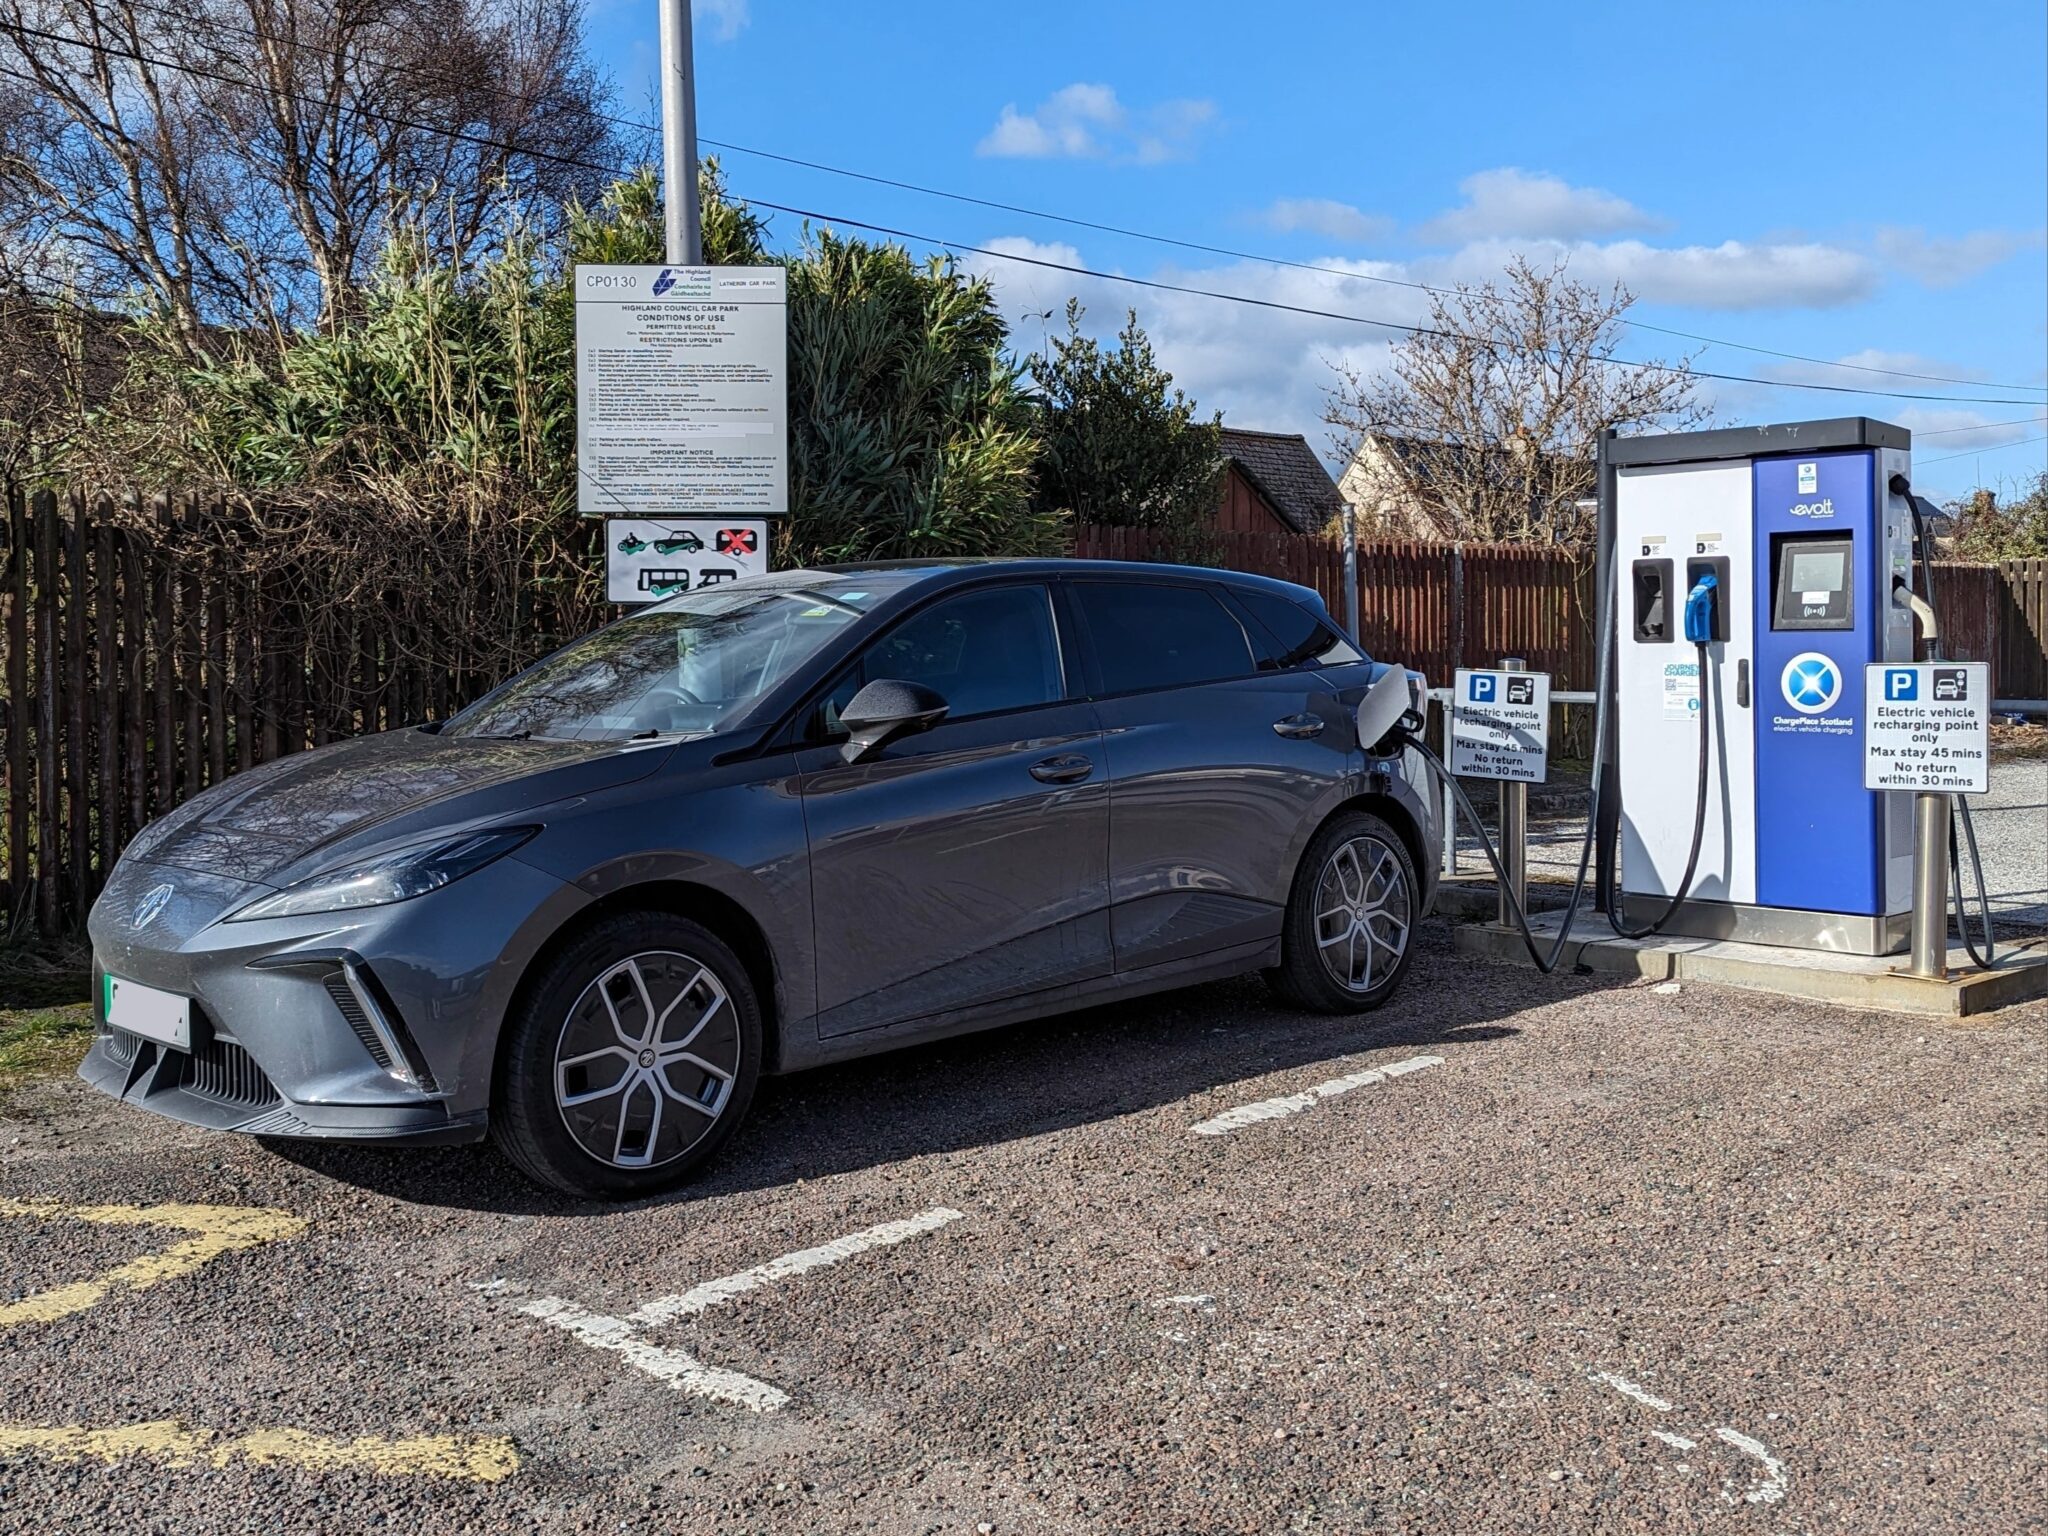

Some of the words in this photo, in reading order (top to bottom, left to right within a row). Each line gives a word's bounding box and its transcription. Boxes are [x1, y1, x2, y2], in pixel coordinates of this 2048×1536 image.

[586, 276, 637, 288] CP0130
[1790, 498, 1834, 516] evolt
[1475, 679, 1491, 699] P
[1892, 673, 1912, 698] P
[1464, 707, 1500, 717] Electric
[1504, 709, 1539, 719] vehicle
[1878, 707, 1925, 717] Electric
[1930, 708, 1975, 717] vehicle
[1460, 718, 1512, 730] recharging
[1515, 722, 1541, 731] point
[1774, 717, 1819, 726] ChargePlace
[1874, 720, 1940, 732] recharging
[1945, 720, 1979, 732] point
[1489, 729, 1510, 740] only
[1823, 726, 1853, 735] charging
[1912, 733, 1938, 744] only
[1457, 740, 1476, 749] Max
[1480, 742, 1500, 752] stay
[1520, 745, 1543, 754] mins
[1871, 746, 1896, 756] Max
[1901, 748, 1926, 759] stay
[1931, 748, 1949, 758] 45
[1952, 749, 1982, 758] mins
[1475, 754, 1488, 763] No
[1492, 756, 1523, 766] return
[1462, 764, 1491, 774] within
[1495, 766, 1509, 775] 30
[1512, 768, 1535, 777] mins
[1895, 762, 1912, 772] No
[1917, 763, 1957, 773] return
[1879, 774, 1917, 784] within
[1921, 775, 1940, 785] 30
[1943, 776, 1973, 786] mins
